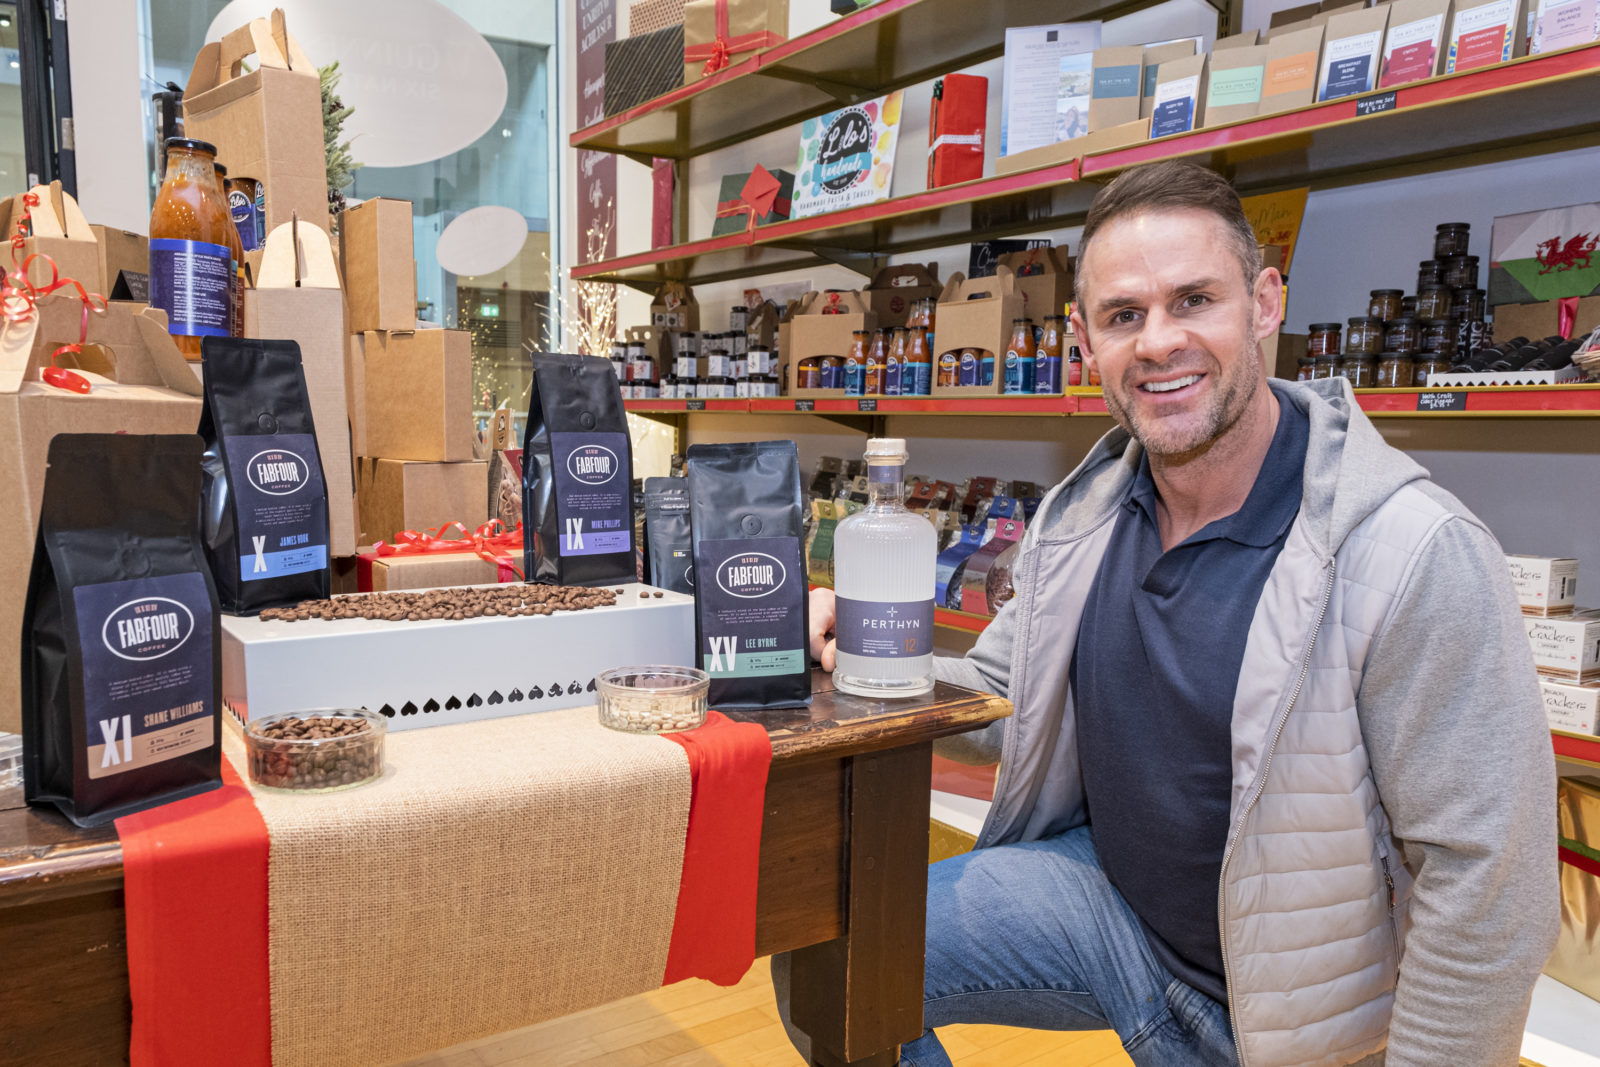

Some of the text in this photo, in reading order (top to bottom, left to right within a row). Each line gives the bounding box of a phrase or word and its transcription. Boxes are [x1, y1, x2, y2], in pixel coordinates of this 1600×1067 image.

[821, 152, 864, 180] handmade
[800, 201, 826, 210] HANDMADE
[827, 196, 844, 205] PASTA
[853, 190, 874, 199] SAUCES
[257, 462, 300, 485] FABFOUR
[576, 456, 610, 474] FABFOUR
[280, 536, 296, 546] JAMES
[566, 518, 584, 550] IX
[252, 535, 267, 573] X
[728, 565, 774, 587] FABFOUR
[118, 612, 180, 649] FABFOUR
[863, 619, 920, 629] PERTHYN
[138, 644, 166, 653] COFFEE
[708, 636, 737, 672] XV
[746, 638, 777, 648] LEE BYRNE
[144, 700, 204, 728] SHANE WILLIAMS
[99, 714, 132, 768] XI
